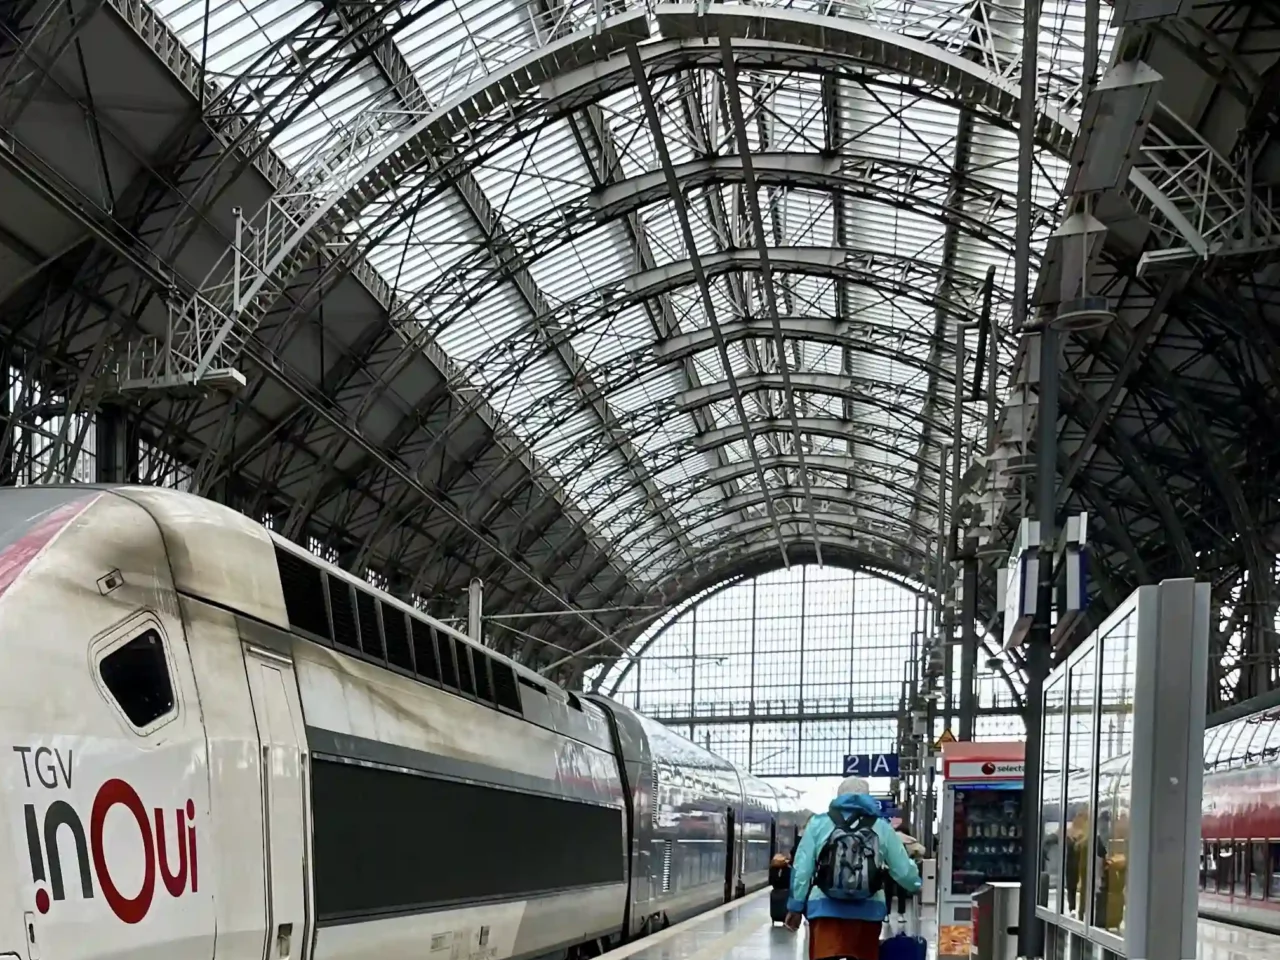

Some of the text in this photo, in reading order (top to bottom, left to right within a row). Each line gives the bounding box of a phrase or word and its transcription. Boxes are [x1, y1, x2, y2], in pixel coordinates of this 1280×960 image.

[12, 746, 73, 789] TGV
[846, 754, 890, 773] 2 A
